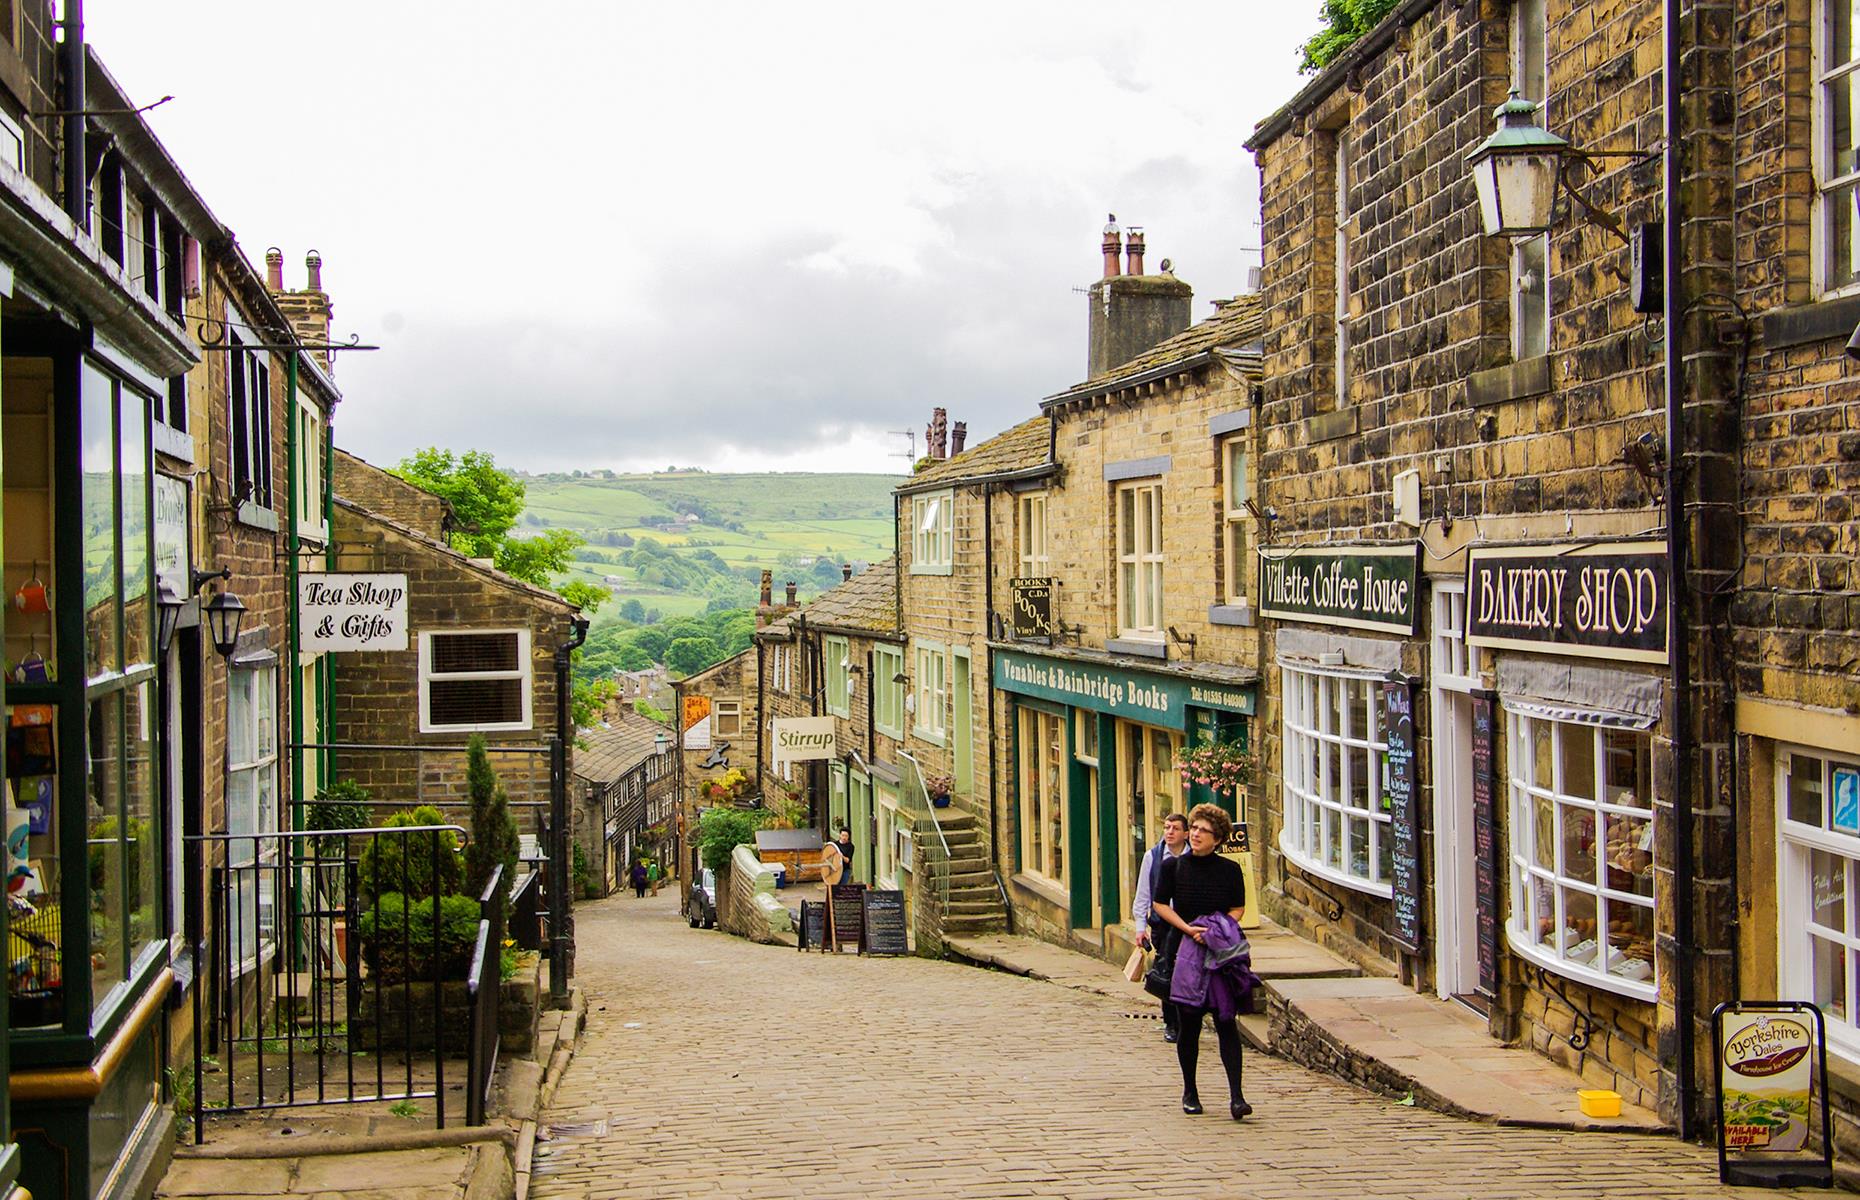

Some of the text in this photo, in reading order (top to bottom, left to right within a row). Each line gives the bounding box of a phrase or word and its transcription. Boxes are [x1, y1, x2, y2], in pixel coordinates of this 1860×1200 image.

[305, 581, 402, 611] Tea Shop
[1014, 579, 1048, 587] BOOKS
[1266, 560, 1408, 615] Villette Coffee House
[1014, 590, 1050, 635] BOOKS
[1478, 565, 1657, 635] BAKERY SHOP
[314, 614, 393, 643] & Gifts
[1016, 627, 1036, 635] Vinyl
[1003, 659, 1168, 712] Venables & Bainbridge Books
[779, 731, 833, 749] Stirrup
[1752, 1043, 1784, 1057] Dales
[1730, 1135, 1755, 1145] HERE
